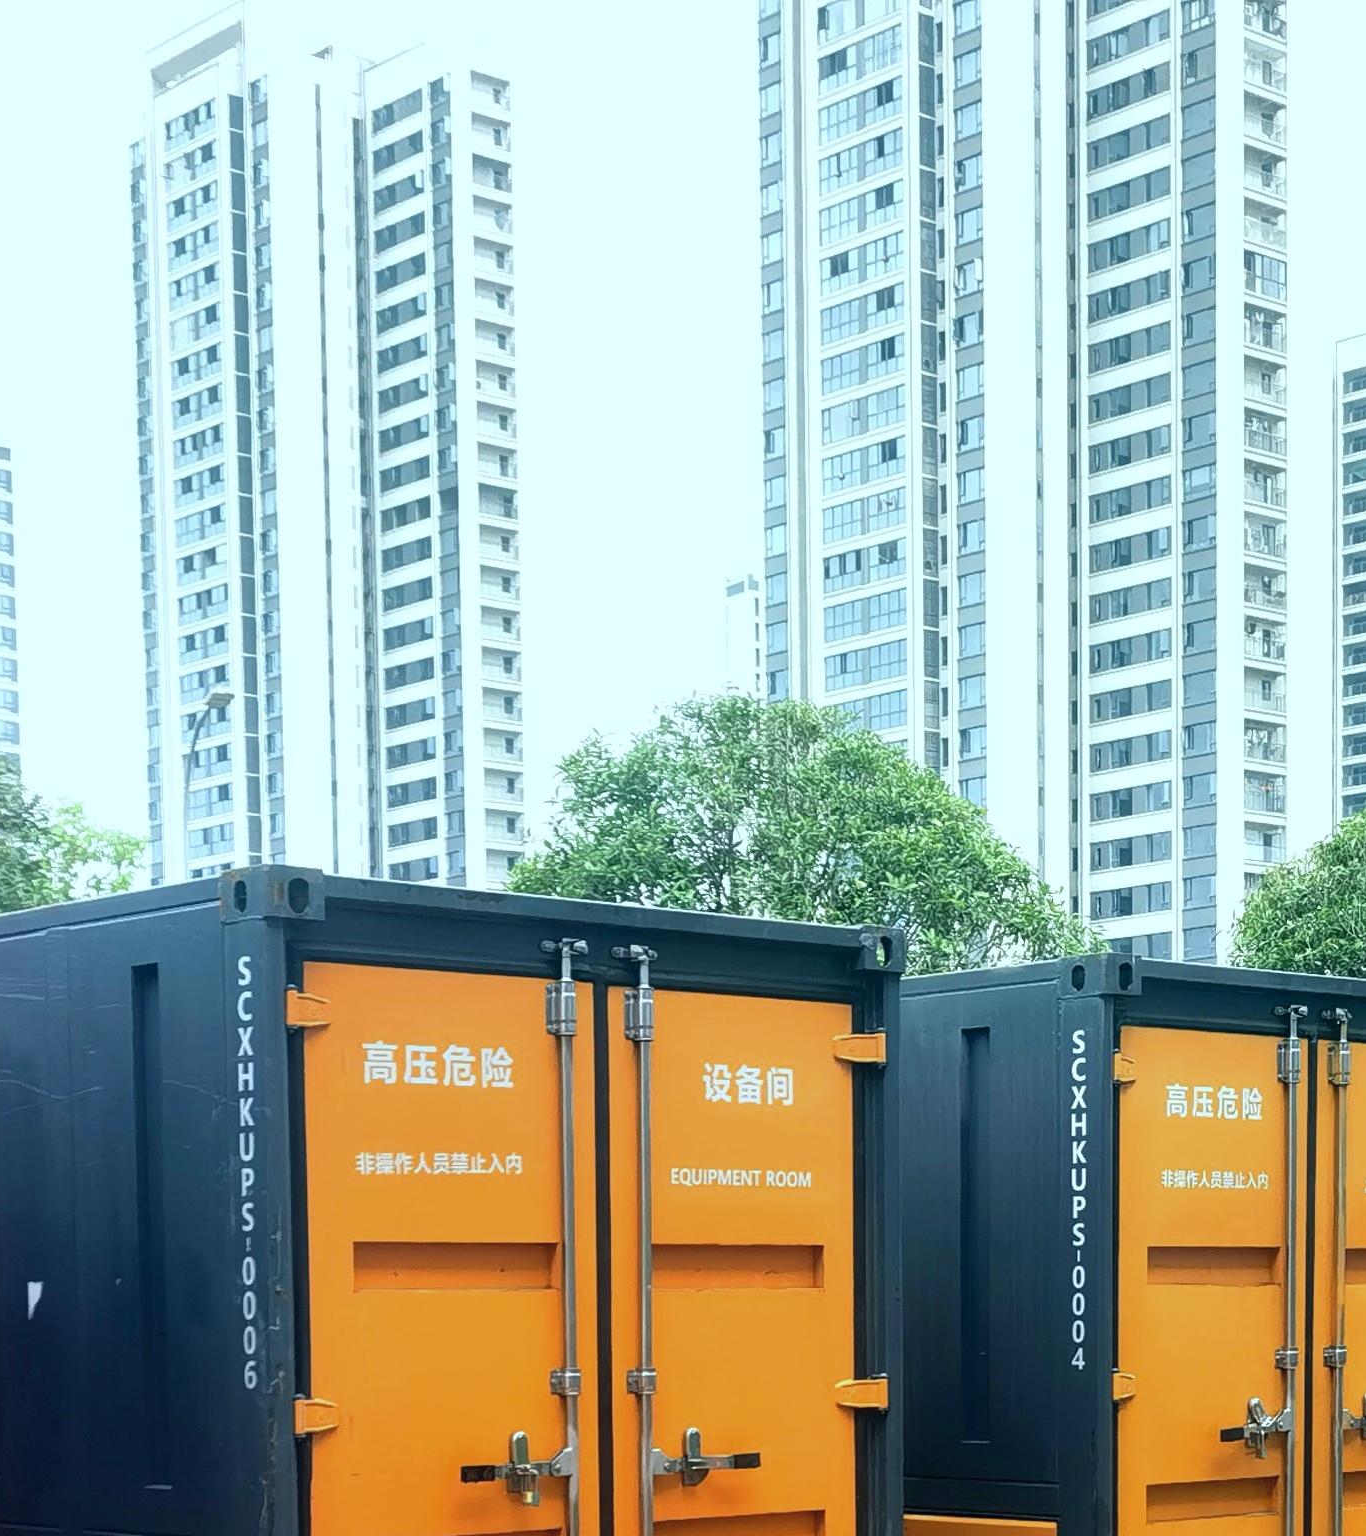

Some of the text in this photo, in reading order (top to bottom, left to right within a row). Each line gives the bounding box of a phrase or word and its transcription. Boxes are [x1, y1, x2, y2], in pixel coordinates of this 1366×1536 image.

[361, 1040, 515, 1089] 高压危险
[701, 1062, 795, 1106] 设备间
[1164, 1083, 1264, 1121] 高压危险
[354, 1152, 523, 1176] 非操作人员禁止入内
[669, 1167, 812, 1188] EQUIPMENT ROOM
[1160, 1169, 1269, 1191] 非操作人员禁止入内
